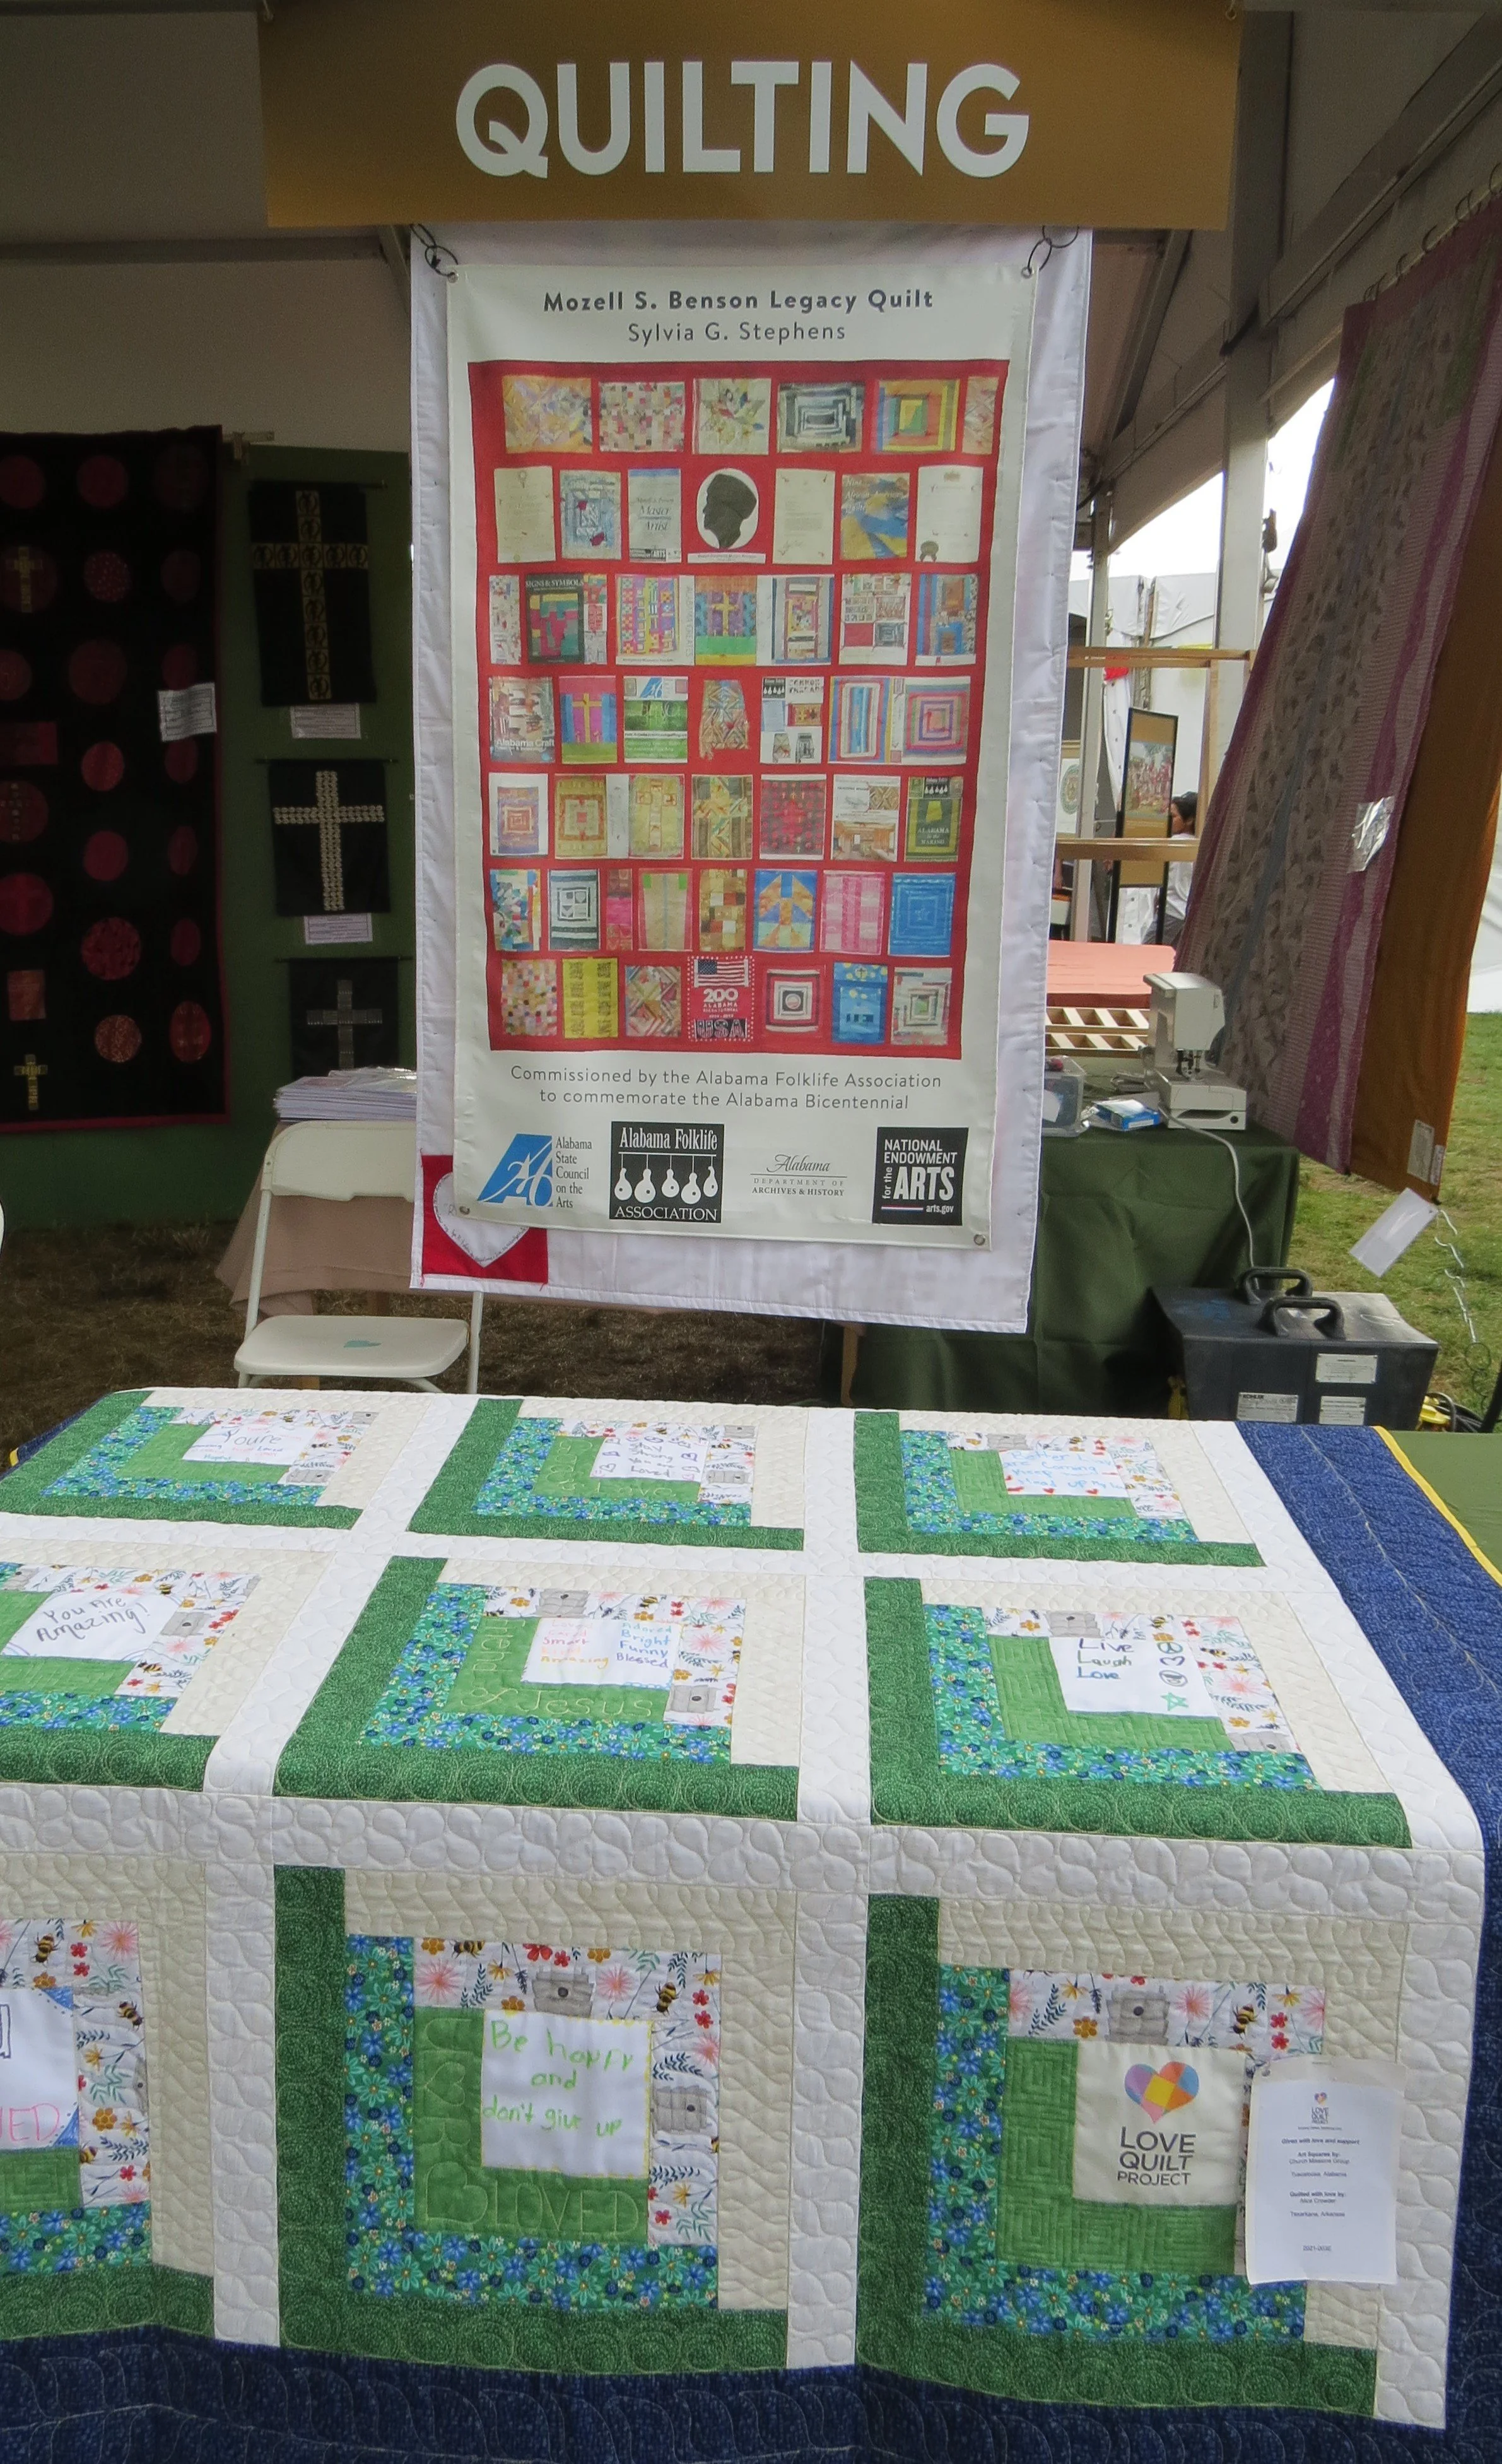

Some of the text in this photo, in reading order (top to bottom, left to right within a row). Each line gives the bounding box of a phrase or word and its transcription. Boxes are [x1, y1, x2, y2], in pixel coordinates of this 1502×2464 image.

[455, 61, 1030, 179] QUILTING
[544, 288, 934, 314] Mozell S. Benson Legacy Quilt
[628, 321, 846, 347] Sylvia G. Stephens
[703, 988, 739, 1003] 200
[696, 1019, 745, 1038] USA
[510, 1065, 941, 1088] Commissioned by the Alabama Folklife Association
[539, 1088, 908, 1109] to commemorate the Alabama Bicentennial
[556, 1136, 592, 1150] Alabama
[619, 1127, 718, 1150] Alabama Folklife
[884, 1139, 943, 1152] NATIONAL
[556, 1151, 578, 1164] State
[766, 1153, 831, 1173] Alabama
[884, 1152, 958, 1164] ENDOWMENT
[556, 1165, 589, 1180] Council
[754, 1177, 826, 1186] DEPARTMENT
[556, 1182, 584, 1194] on the
[751, 1187, 796, 1195] ARCHIVES
[807, 1188, 845, 1196] HISTORY
[882, 1167, 893, 1200] for the
[893, 1166, 955, 1201] ARTS
[556, 1196, 573, 1208] Arts
[925, 1204, 954, 1215] arts.gov
[614, 1206, 717, 1221] ASSOCIATION
[44, 1597, 127, 1624] You Are
[36, 1602, 151, 1642] Amazing!
[622, 1622, 672, 1634] Adored
[621, 1629, 671, 1648] Bright
[1079, 1637, 1134, 1653] Live
[619, 1641, 669, 1659] Funny
[1077, 1649, 1132, 1666] Laugh
[616, 1653, 669, 1669] Blessed
[1076, 1666, 1122, 1680] Love
[515, 1690, 654, 1718] Jesus
[491, 2019, 529, 2053] Be
[530, 2068, 578, 2090] and
[481, 2094, 534, 2125] don't
[0, 2102, 60, 2142] ED
[1120, 2126, 1197, 2154] LOVE
[1119, 2150, 1194, 2171] QUILT
[1117, 2171, 1192, 2186] PROJECT
[495, 2179, 639, 2235] LOVED
